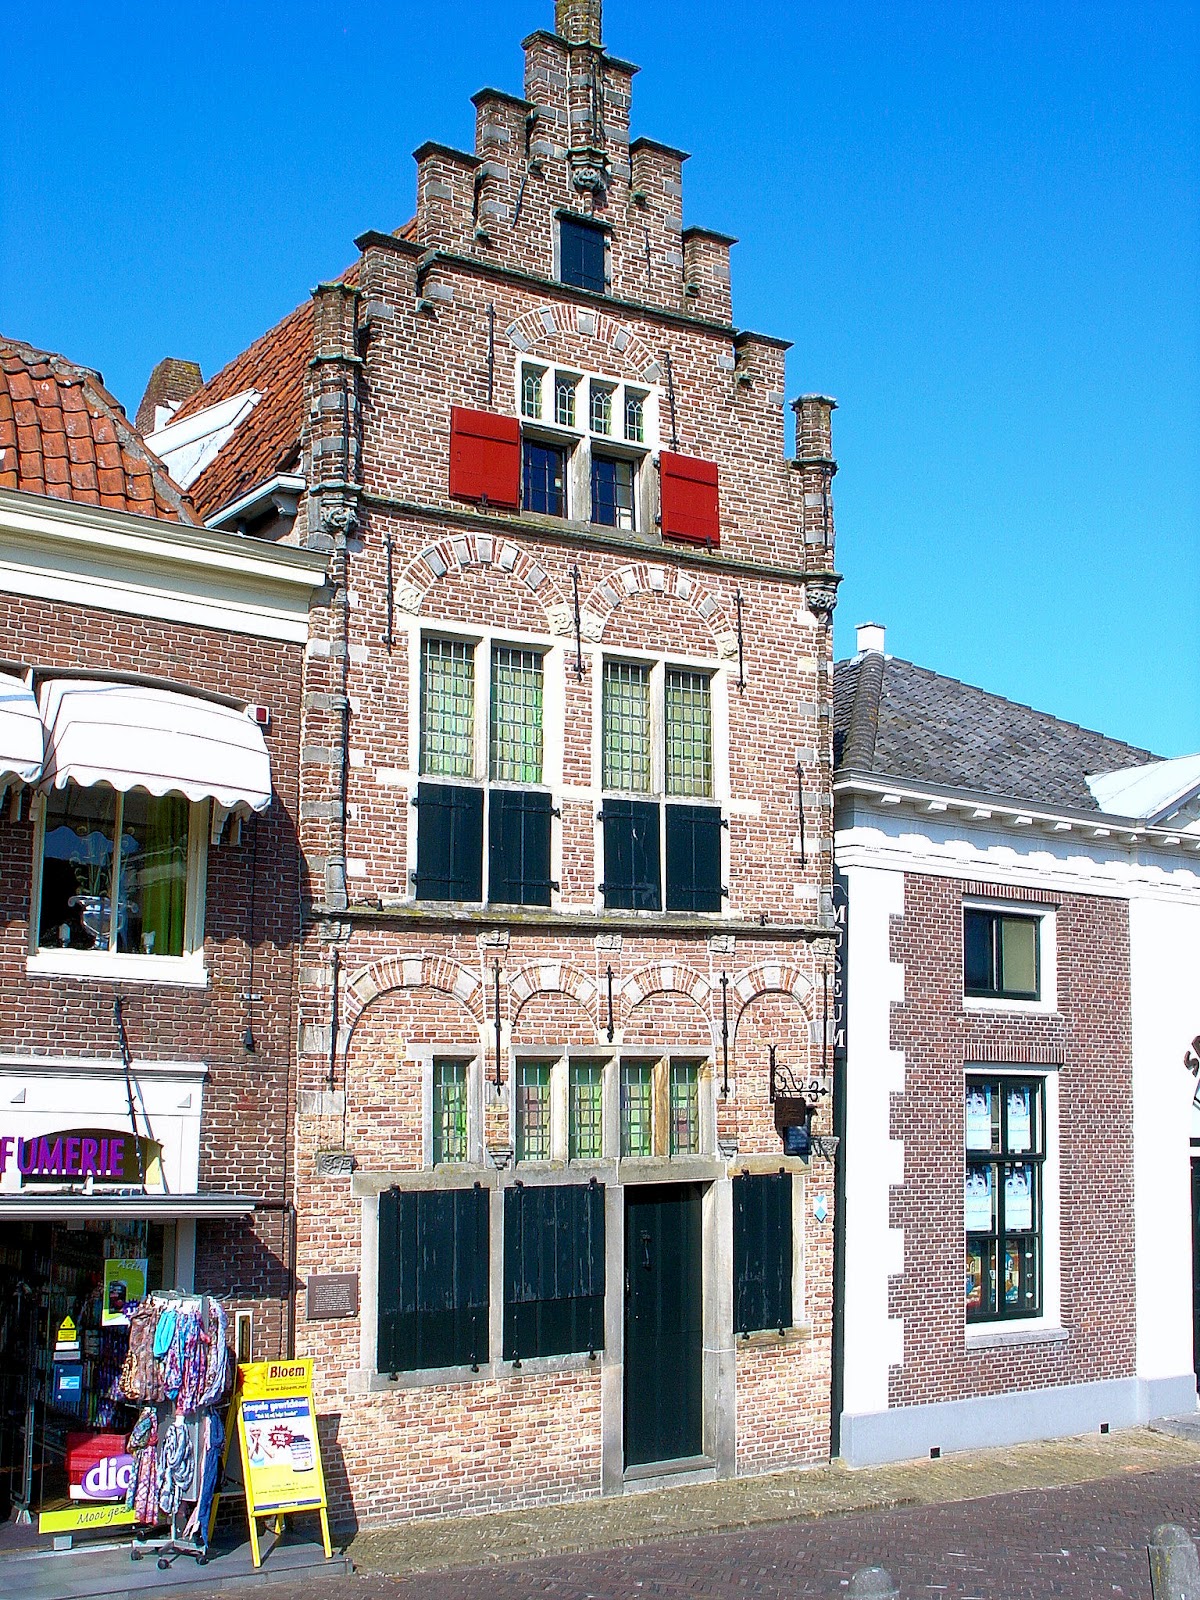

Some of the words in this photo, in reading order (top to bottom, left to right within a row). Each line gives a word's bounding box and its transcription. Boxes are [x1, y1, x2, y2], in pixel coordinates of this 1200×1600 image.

[269, 1366, 305, 1379] Bloem
[77, 1508, 106, 1525] Mooi
[105, 1506, 127, 1525] gez
